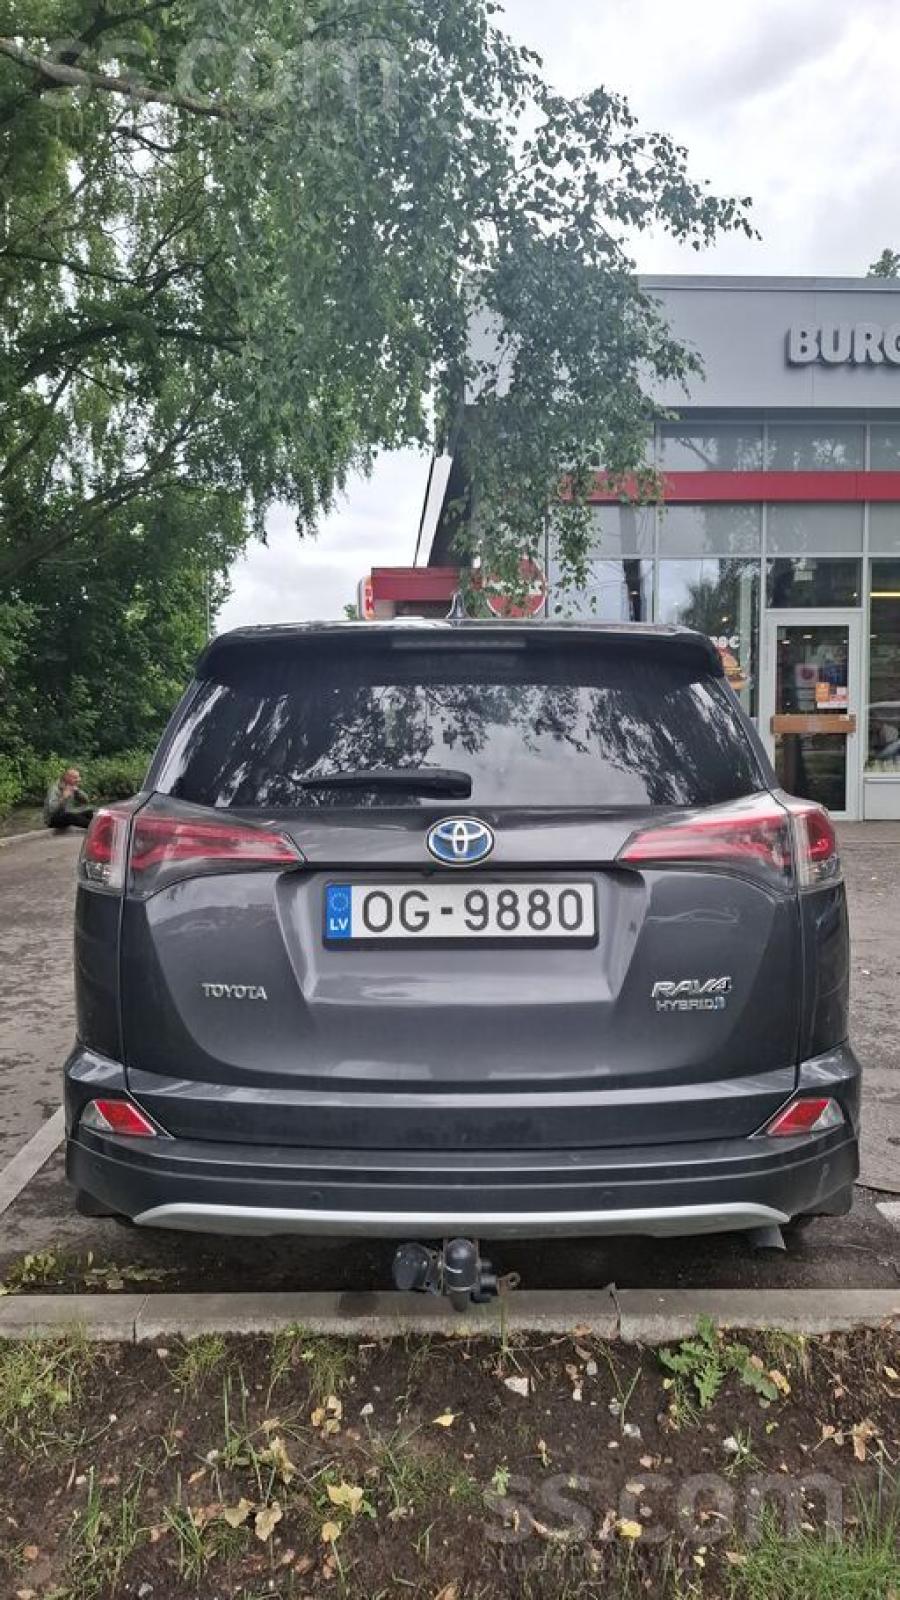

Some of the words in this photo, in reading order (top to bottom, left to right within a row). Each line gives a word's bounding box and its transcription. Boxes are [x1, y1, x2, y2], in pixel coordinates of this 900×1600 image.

[362, 889, 584, 933] OG-9880
[329, 918, 348, 931] LV
[201, 983, 268, 1000] TOYOTA
[651, 976, 732, 998] RAV4
[656, 998, 715, 1011] HYBRID
